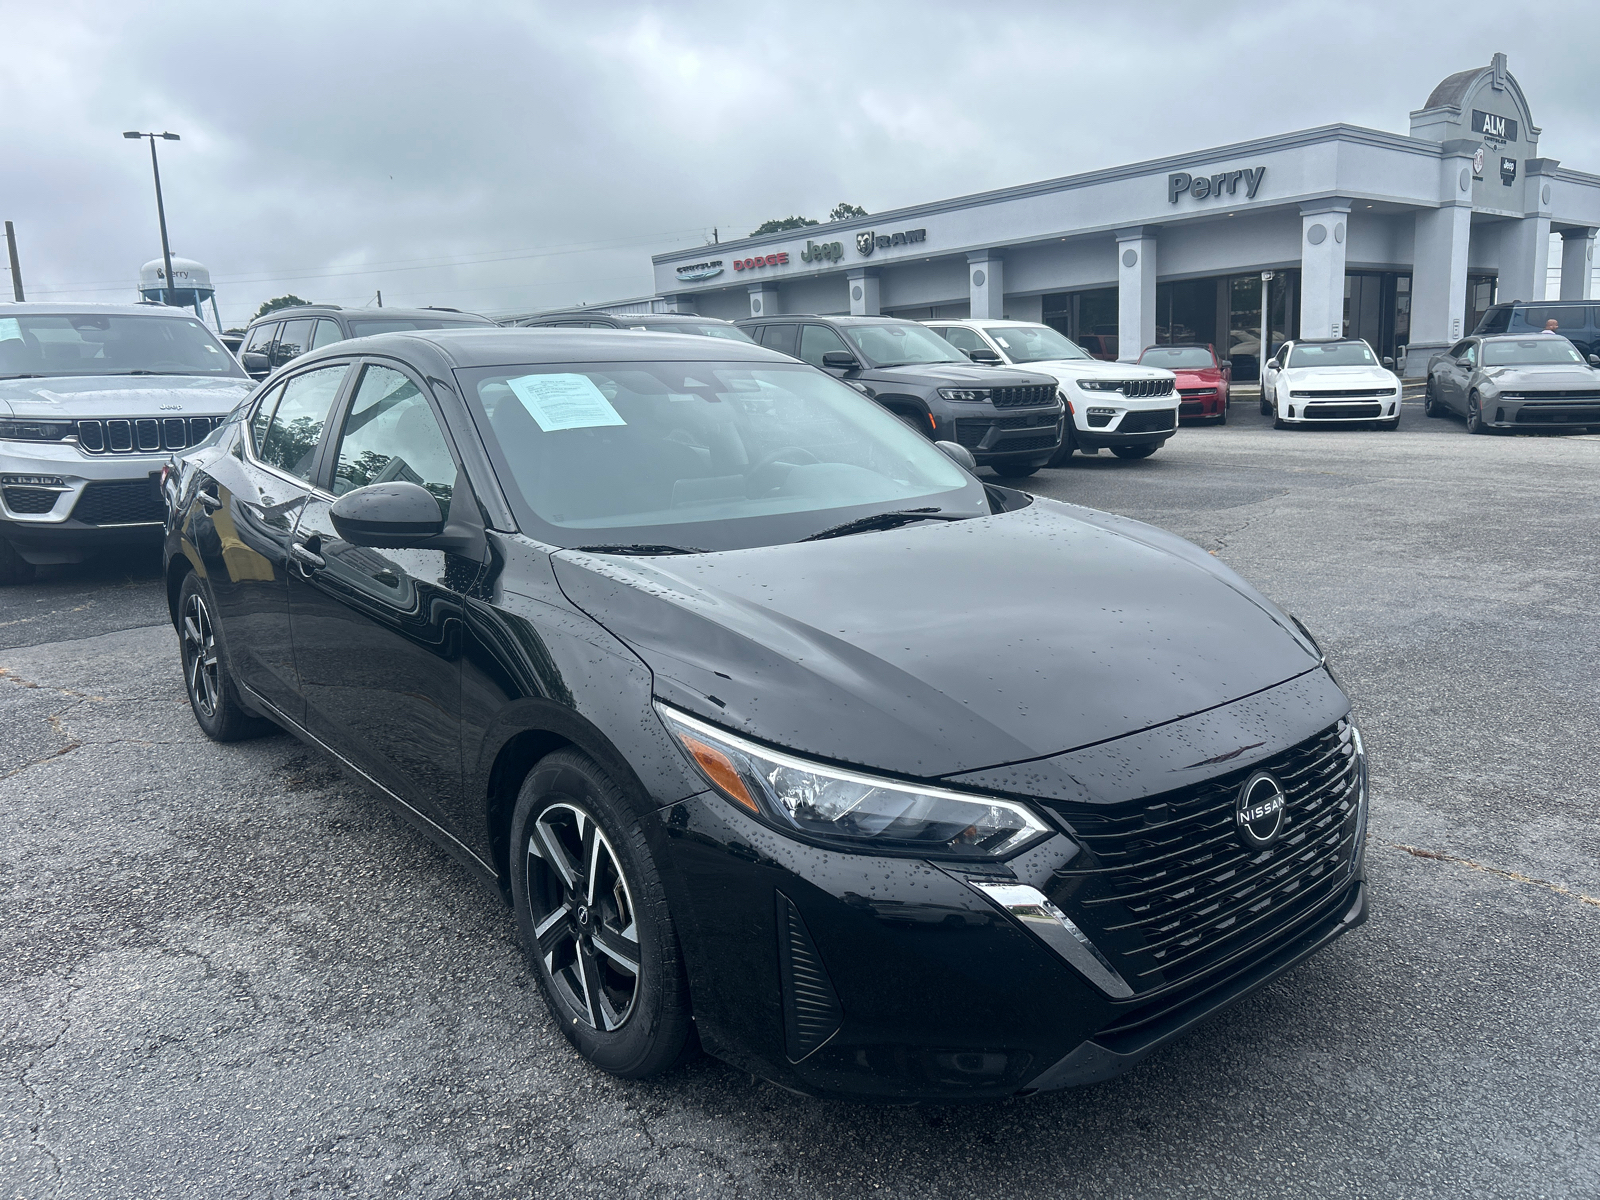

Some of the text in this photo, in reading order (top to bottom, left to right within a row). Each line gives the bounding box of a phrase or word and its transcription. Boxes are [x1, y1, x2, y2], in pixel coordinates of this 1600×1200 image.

[1483, 114, 1505, 137] ALM
[1504, 160, 1514, 171] Jeep
[1168, 166, 1266, 204] Perry
[875, 228, 926, 249] RAM
[733, 253, 789, 271] DODGE
[801, 241, 843, 263] Jeep
[1240, 794, 1285, 823] NISSAN
